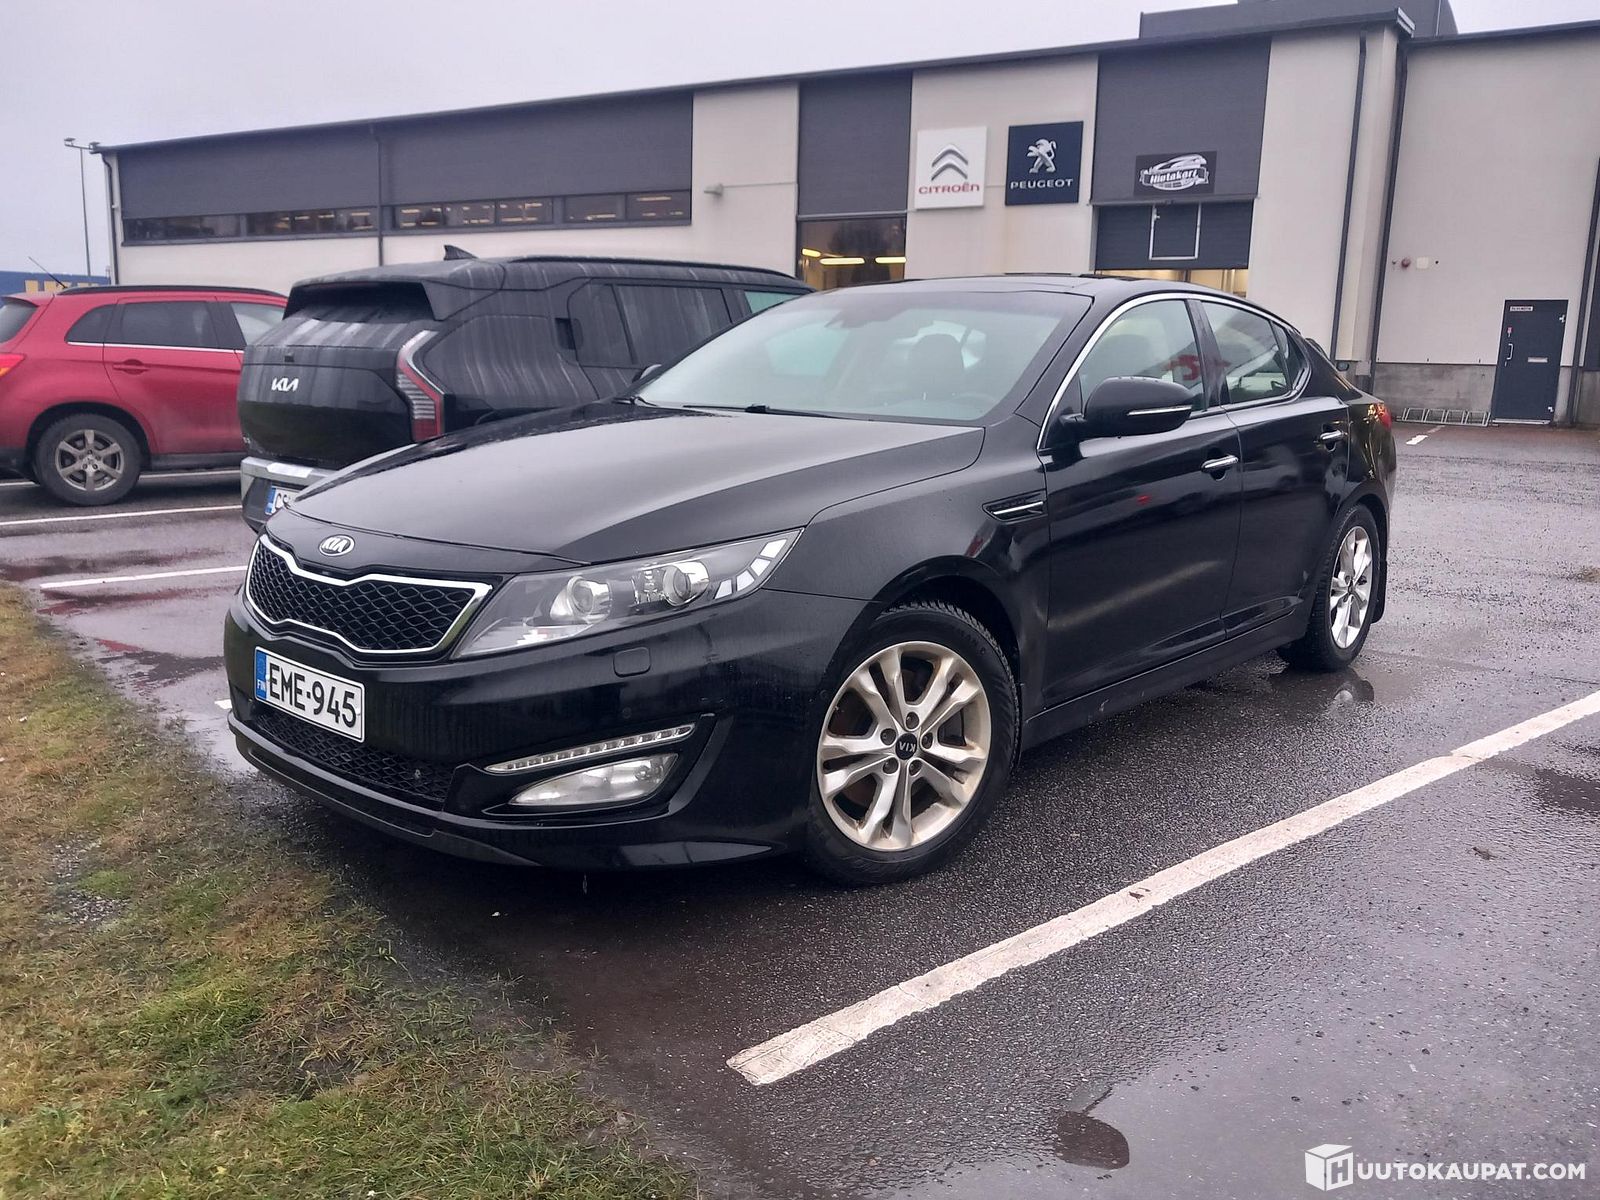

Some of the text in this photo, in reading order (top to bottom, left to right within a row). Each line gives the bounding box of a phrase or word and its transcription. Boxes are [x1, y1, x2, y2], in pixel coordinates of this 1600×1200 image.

[1010, 178, 1073, 190] PEUGEOT
[271, 377, 299, 391] KIA
[321, 536, 349, 552] KIA
[269, 662, 357, 728] EME-945
